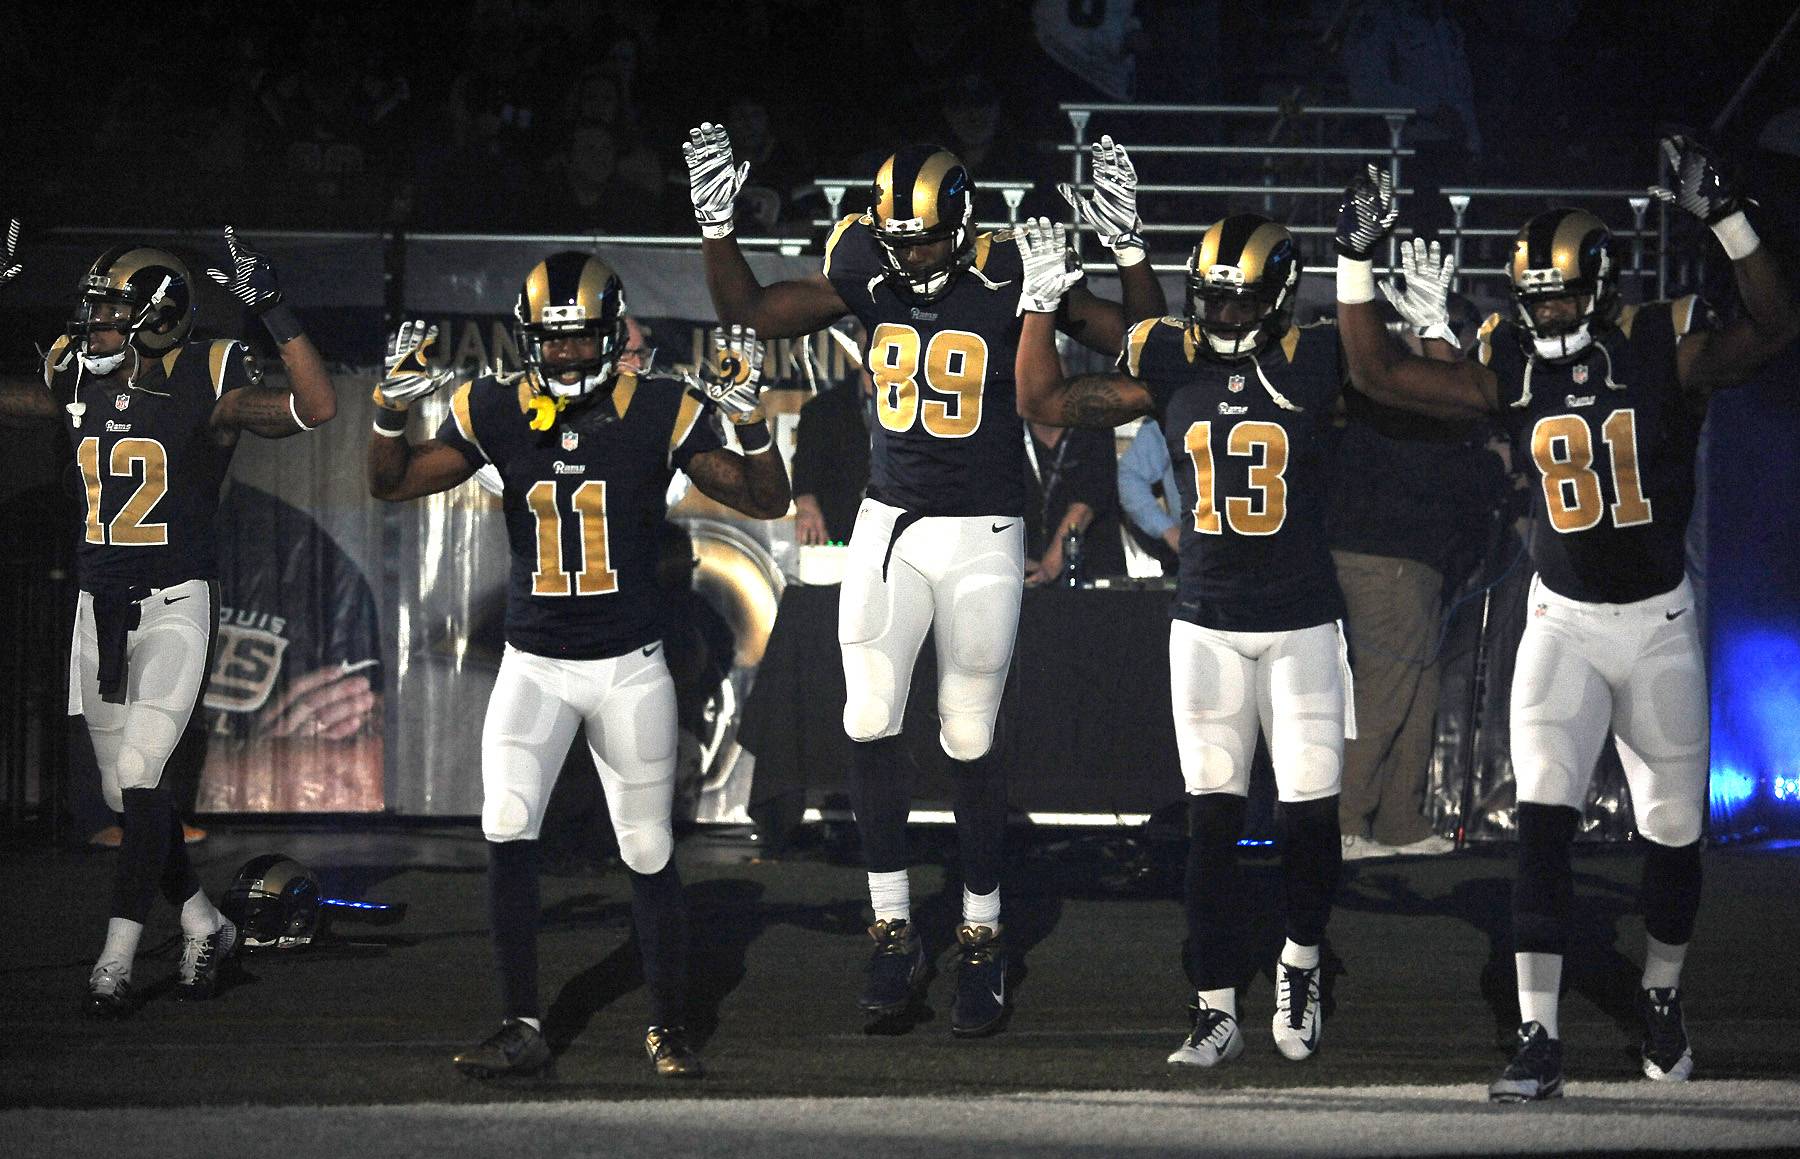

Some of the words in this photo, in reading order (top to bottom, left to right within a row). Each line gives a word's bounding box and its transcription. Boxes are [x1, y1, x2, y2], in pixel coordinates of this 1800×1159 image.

[105, 419, 132, 432] Rams
[868, 322, 989, 439] 89
[76, 436, 169, 546] 12
[1184, 420, 1290, 536] 13
[1530, 408, 1653, 534] 81
[526, 480, 620, 596] 11
